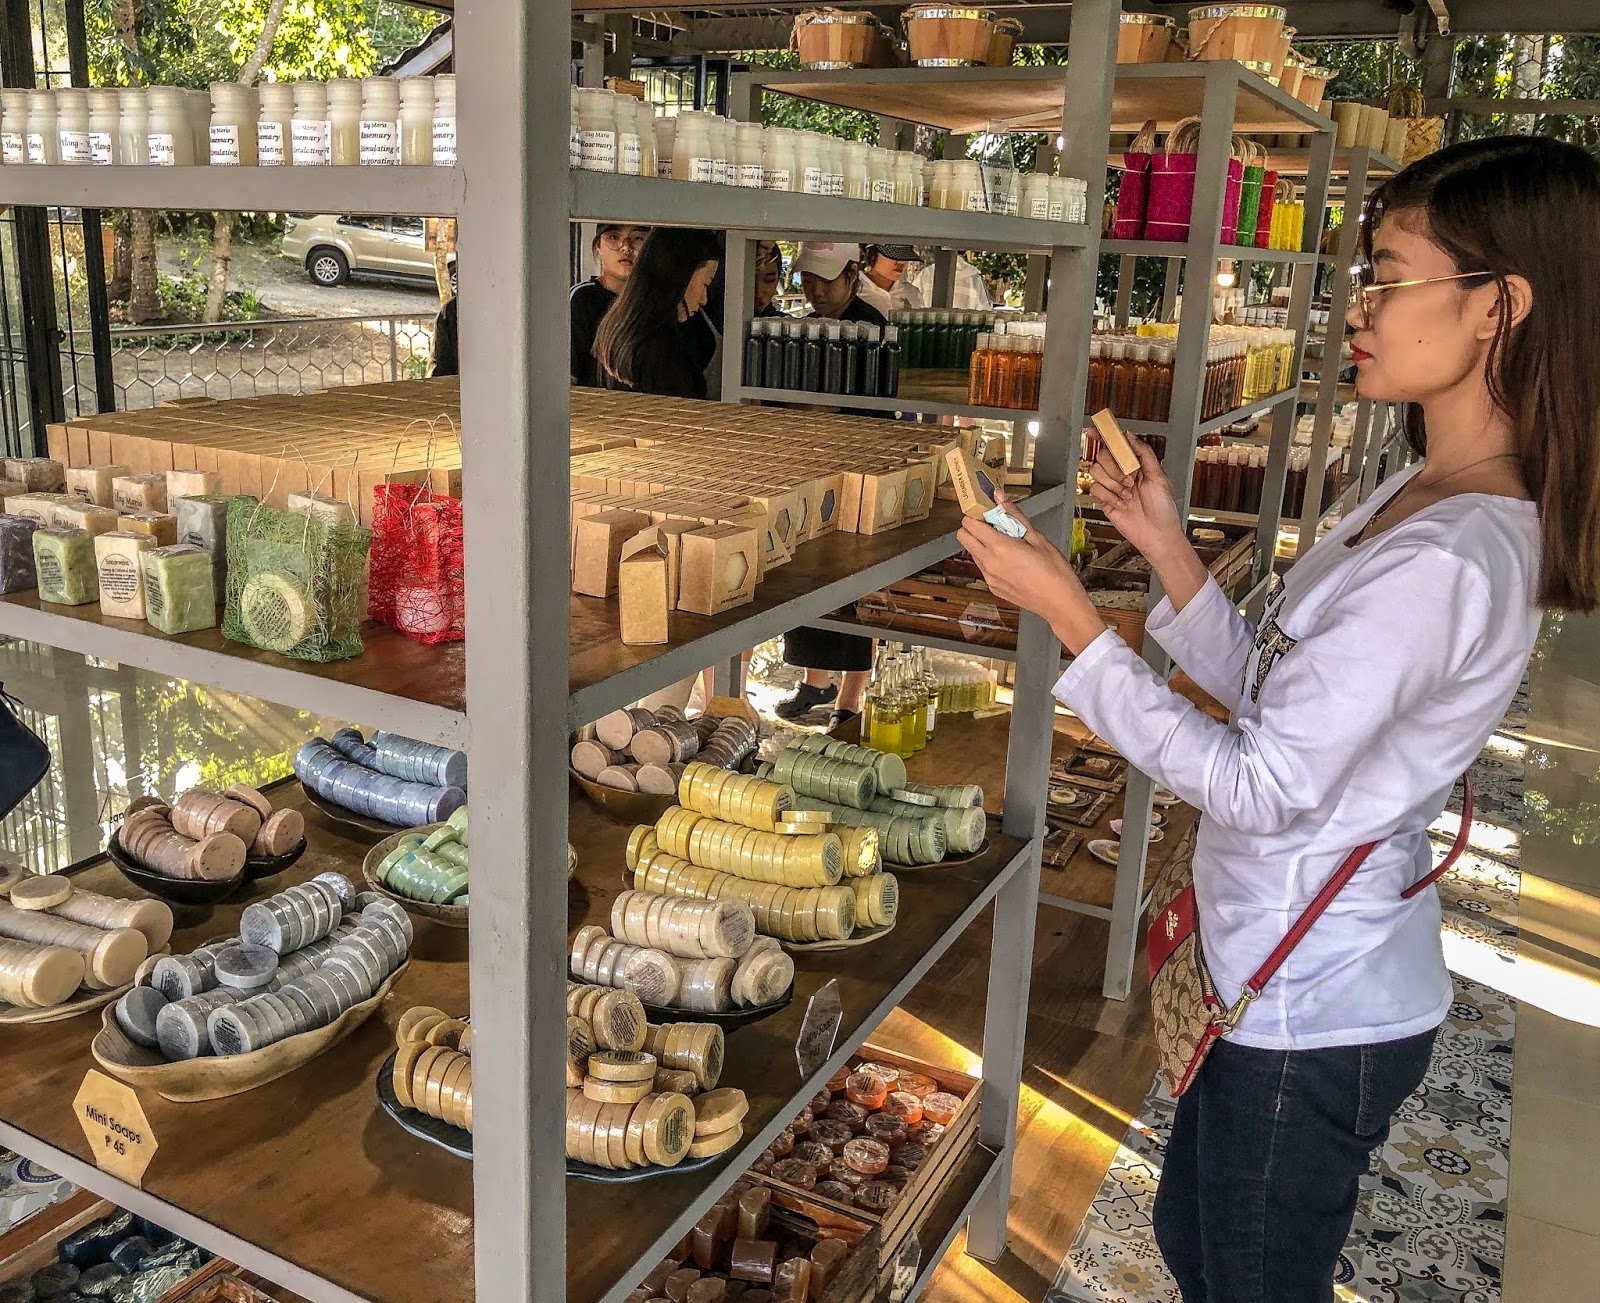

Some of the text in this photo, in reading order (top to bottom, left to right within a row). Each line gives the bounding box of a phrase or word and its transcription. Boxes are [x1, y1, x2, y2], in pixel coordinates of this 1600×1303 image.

[86, 1104, 142, 1145] Mini Soaps
[114, 1140, 126, 1156] 45
